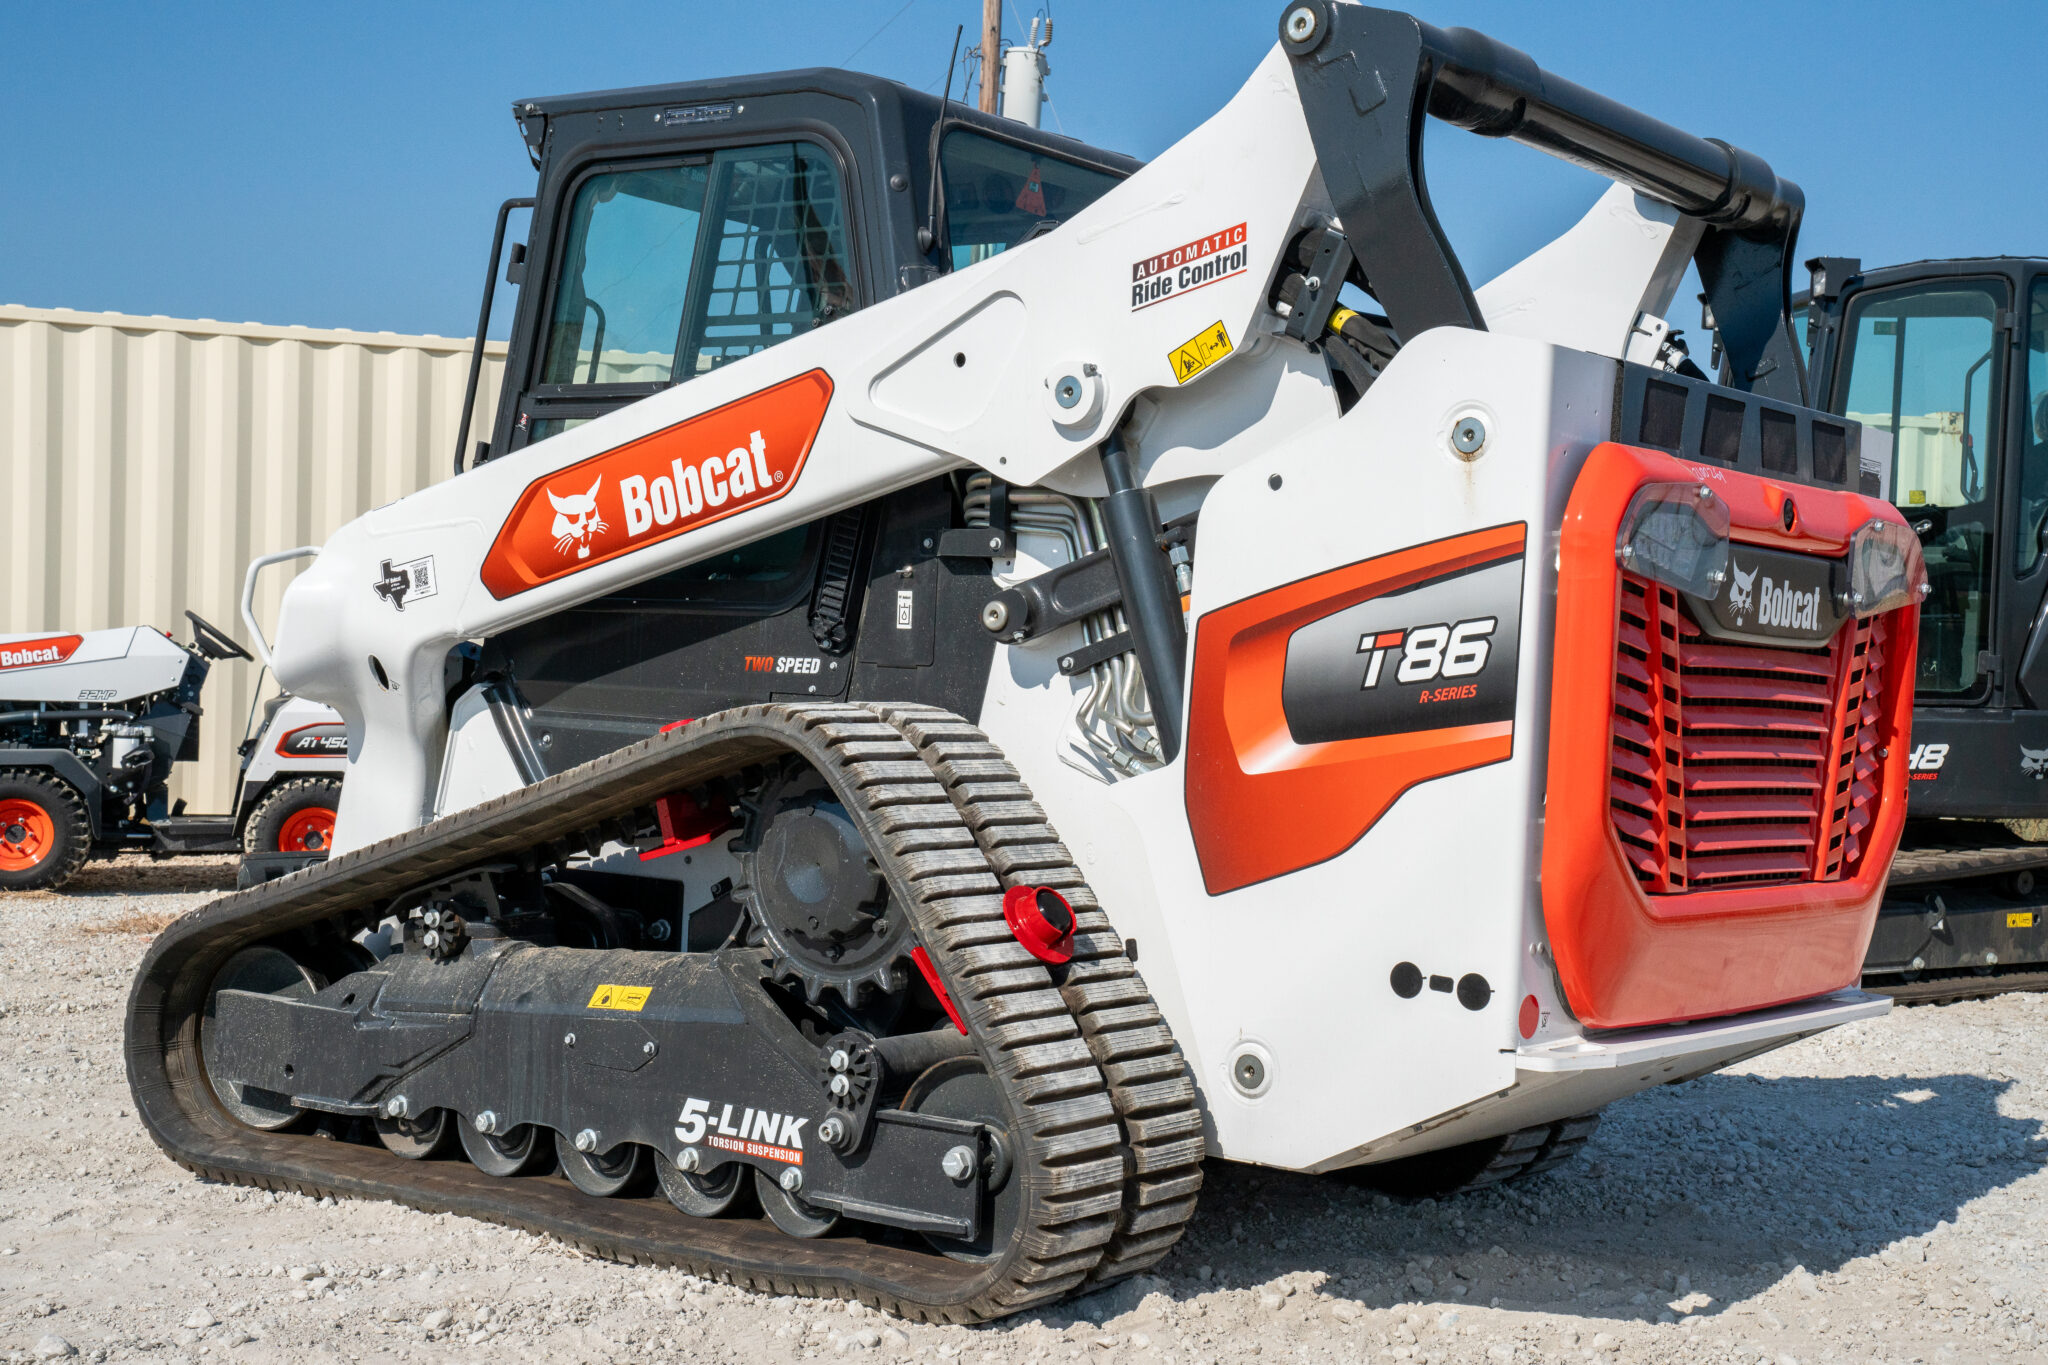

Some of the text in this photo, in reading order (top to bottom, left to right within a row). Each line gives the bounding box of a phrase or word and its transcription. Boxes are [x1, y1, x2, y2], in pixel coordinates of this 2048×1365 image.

[1136, 227, 1243, 279] AUTOMATIC
[1132, 244, 1247, 307] Ride Control
[744, 656, 821, 674] TWO SPEED
[1358, 616, 1498, 691] T86
[78, 689, 117, 700] 32HP
[1419, 684, 1478, 704] R-SERIES
[1909, 772, 1939, 781] -SERIES
[674, 1097, 810, 1149] 5-LINK
[708, 1135, 801, 1163] TORSION SUSPENSION
